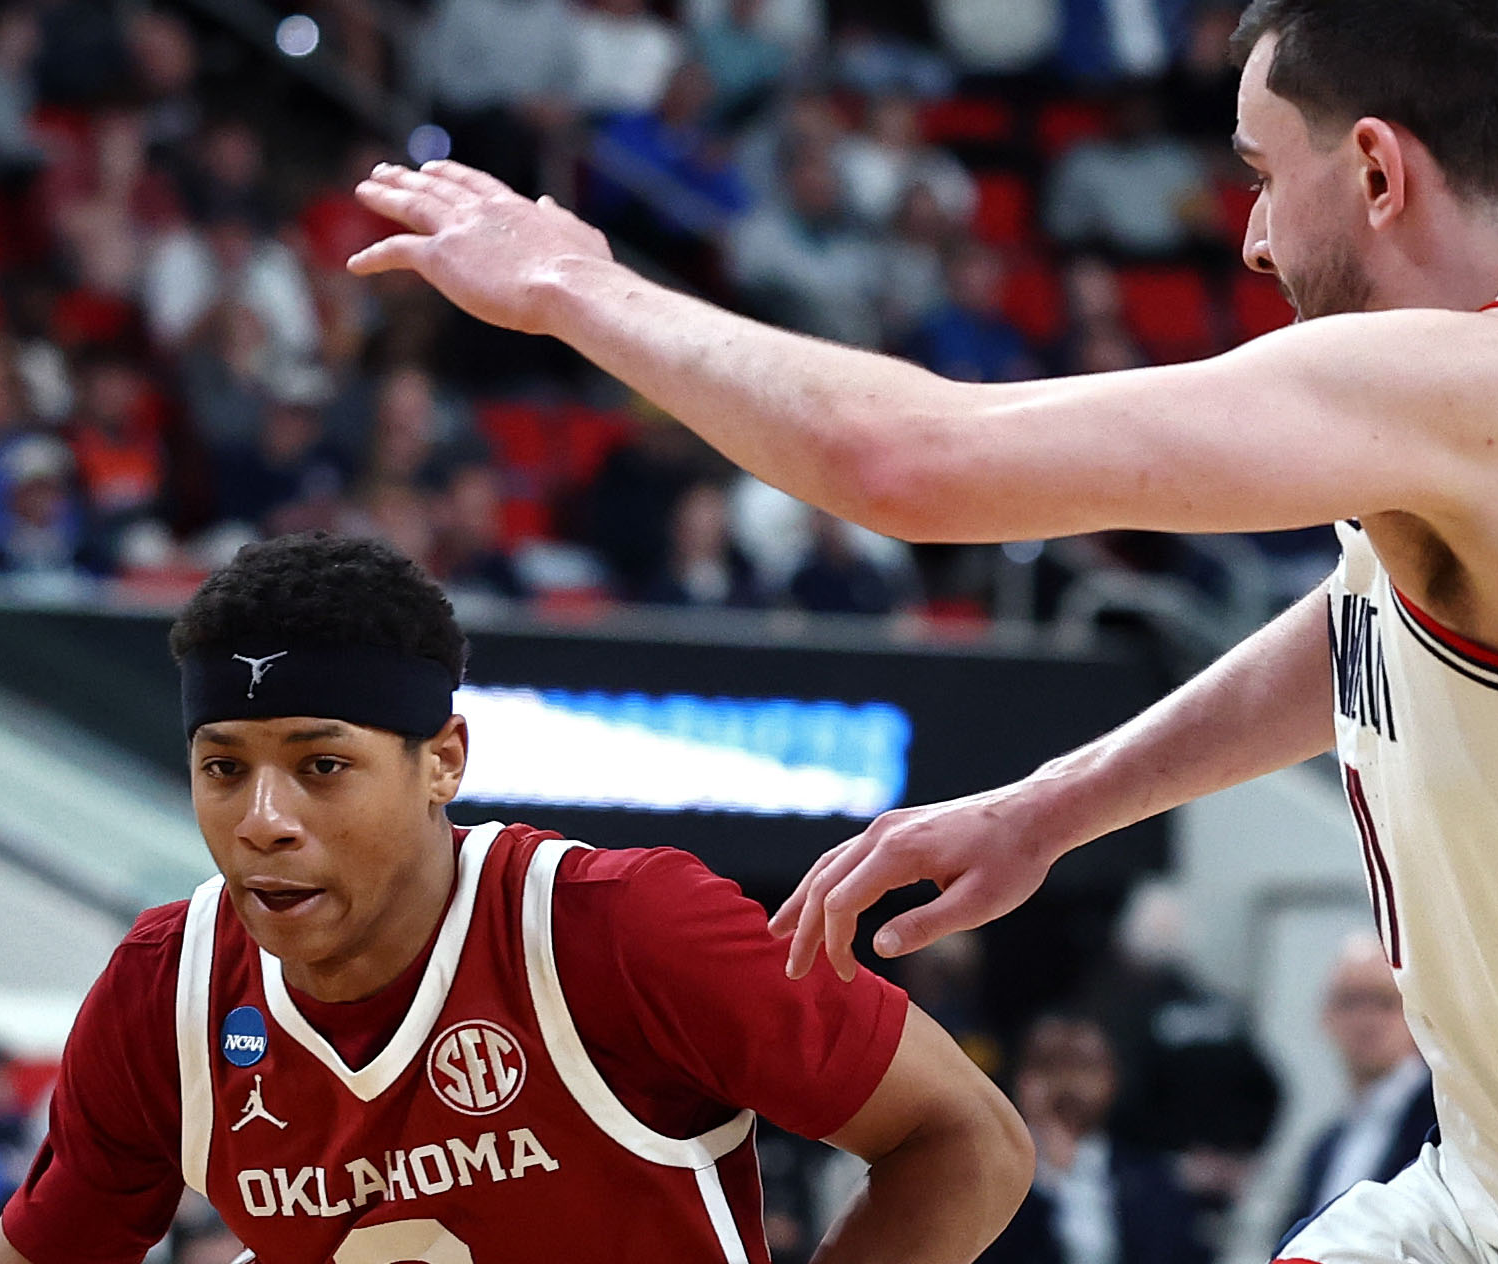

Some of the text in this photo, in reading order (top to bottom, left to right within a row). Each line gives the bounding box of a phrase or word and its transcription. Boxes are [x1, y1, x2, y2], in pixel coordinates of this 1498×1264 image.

[224, 1034, 264, 1051] NCAA
[435, 1028, 519, 1109] SEC
[237, 1127, 560, 1218] OKLAHOMA
